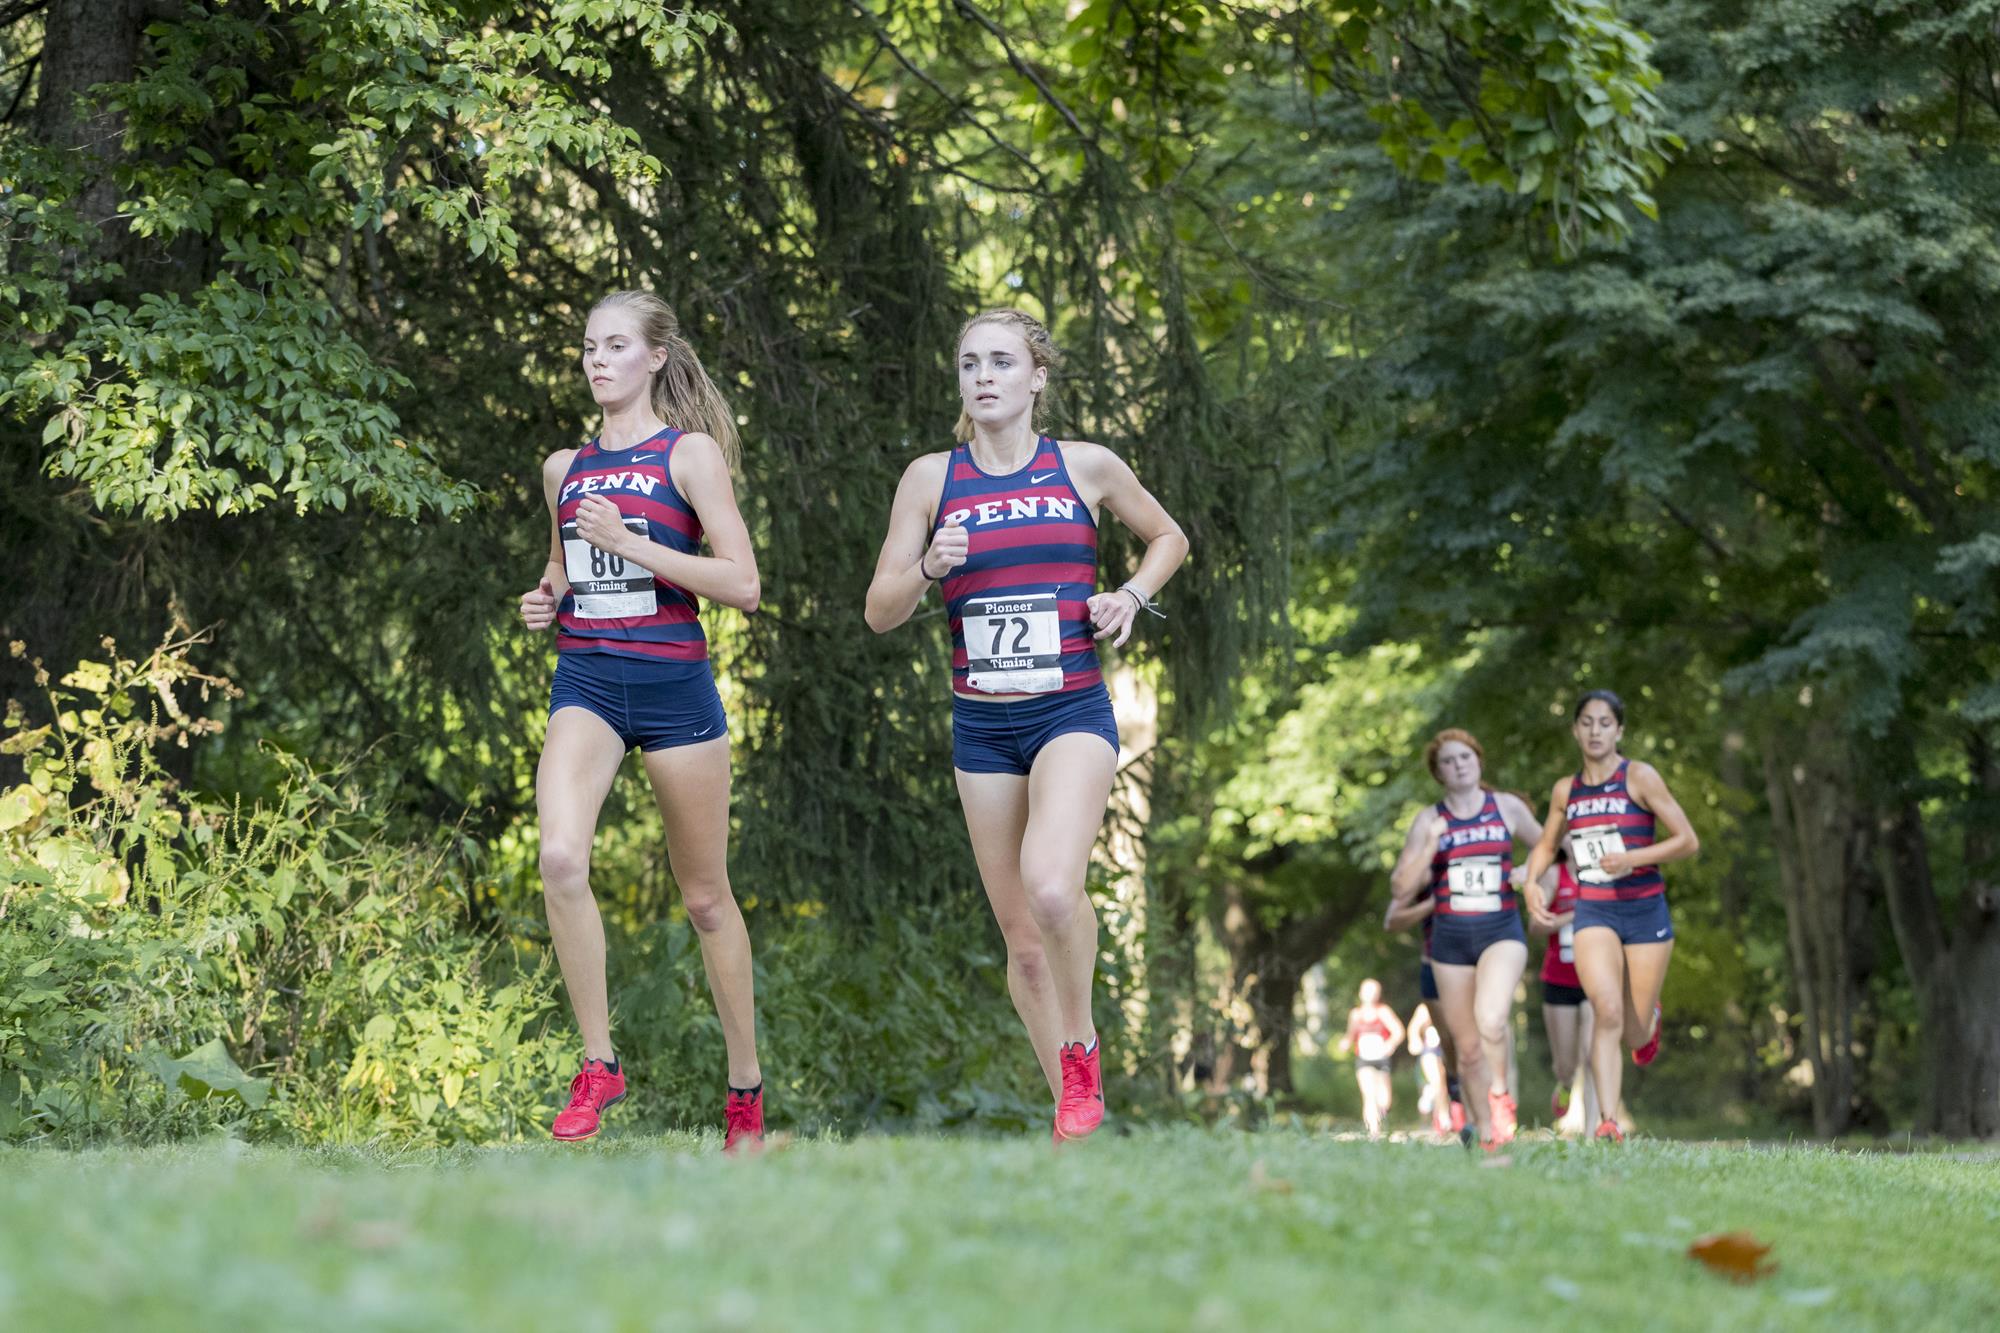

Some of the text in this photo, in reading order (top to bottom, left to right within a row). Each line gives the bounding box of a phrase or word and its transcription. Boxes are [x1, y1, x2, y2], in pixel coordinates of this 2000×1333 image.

[560, 471, 660, 505] PENN
[945, 496, 1077, 527] PENN
[590, 546, 624, 578] 80
[589, 581, 628, 592] Timing
[985, 602, 1033, 614] Pioneer
[988, 616, 1031, 655] 72
[990, 657, 1034, 669] Timing
[1567, 797, 1628, 820] PENN
[1439, 825, 1505, 851] PENN
[1586, 840, 1606, 860] 81
[1464, 871, 1485, 890] 84
